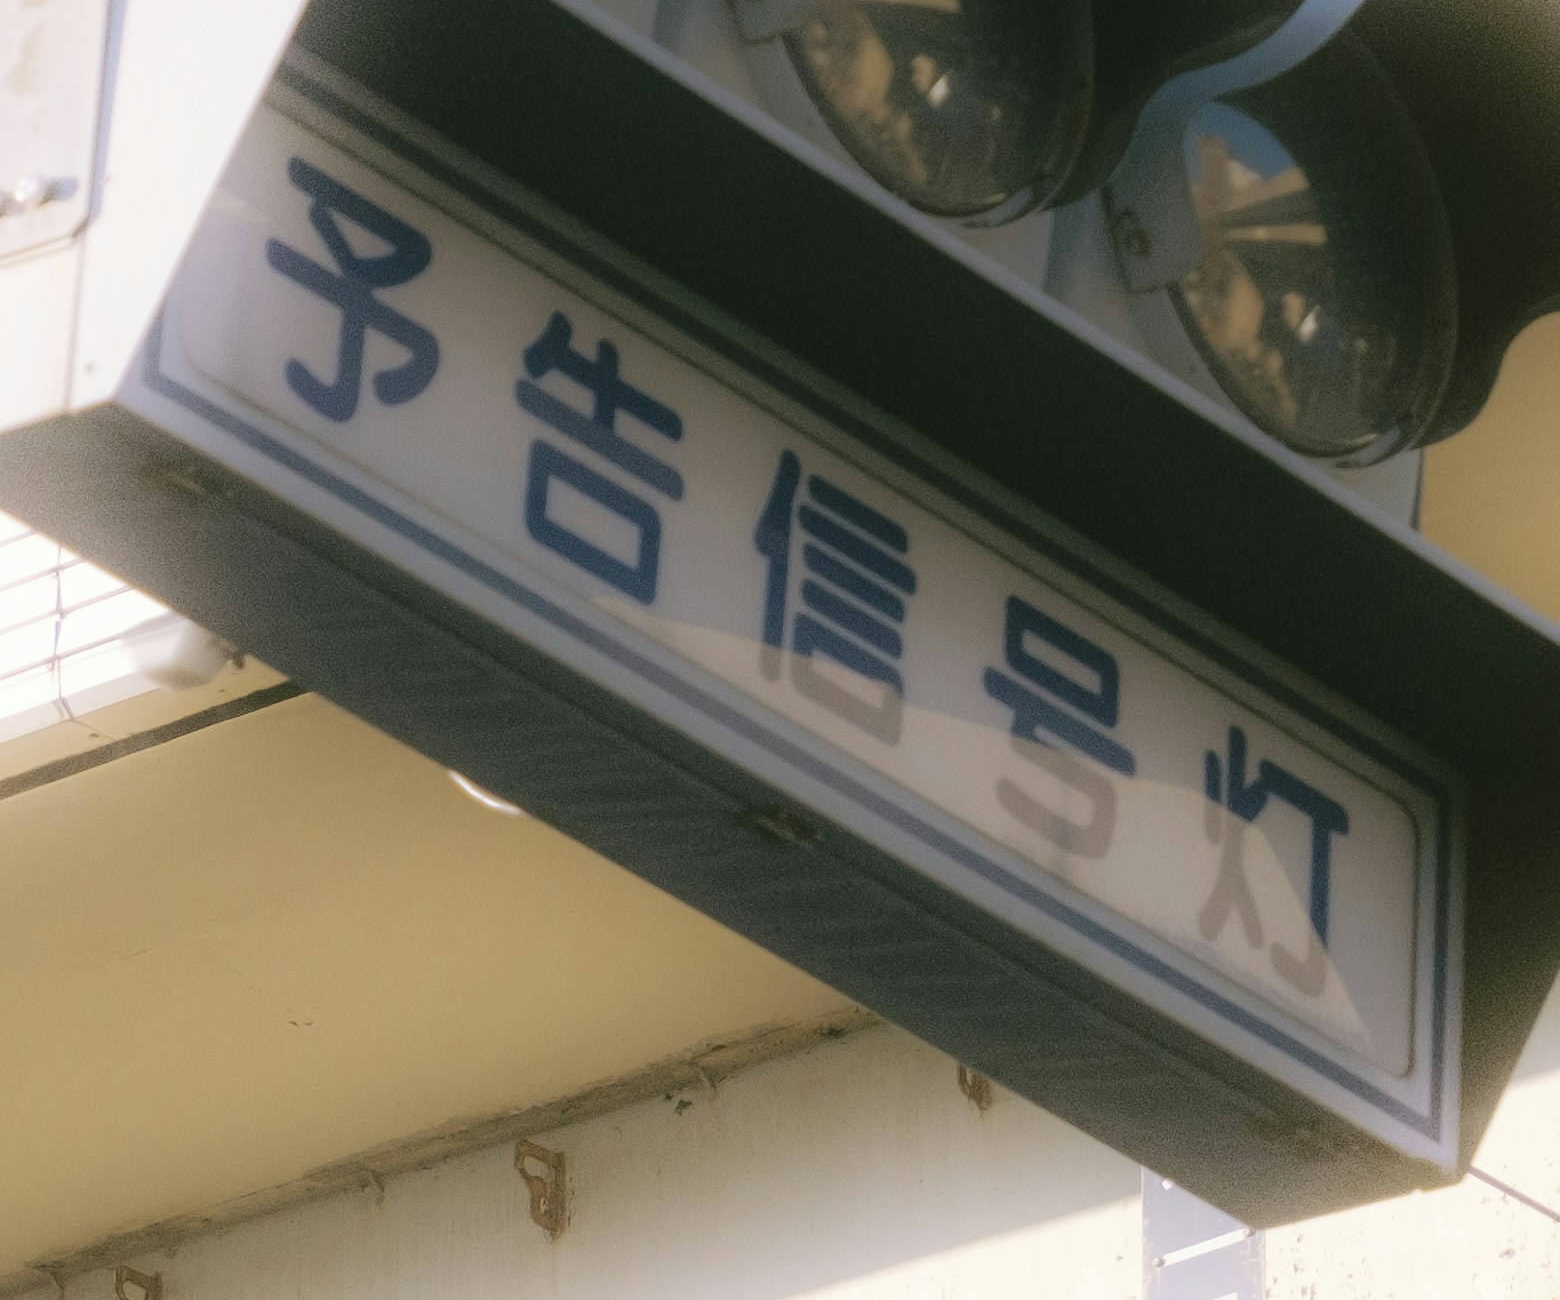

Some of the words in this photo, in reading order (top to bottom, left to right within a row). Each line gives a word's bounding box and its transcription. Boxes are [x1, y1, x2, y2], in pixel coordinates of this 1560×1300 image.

[265, 157, 1348, 997] 予告信号灯
